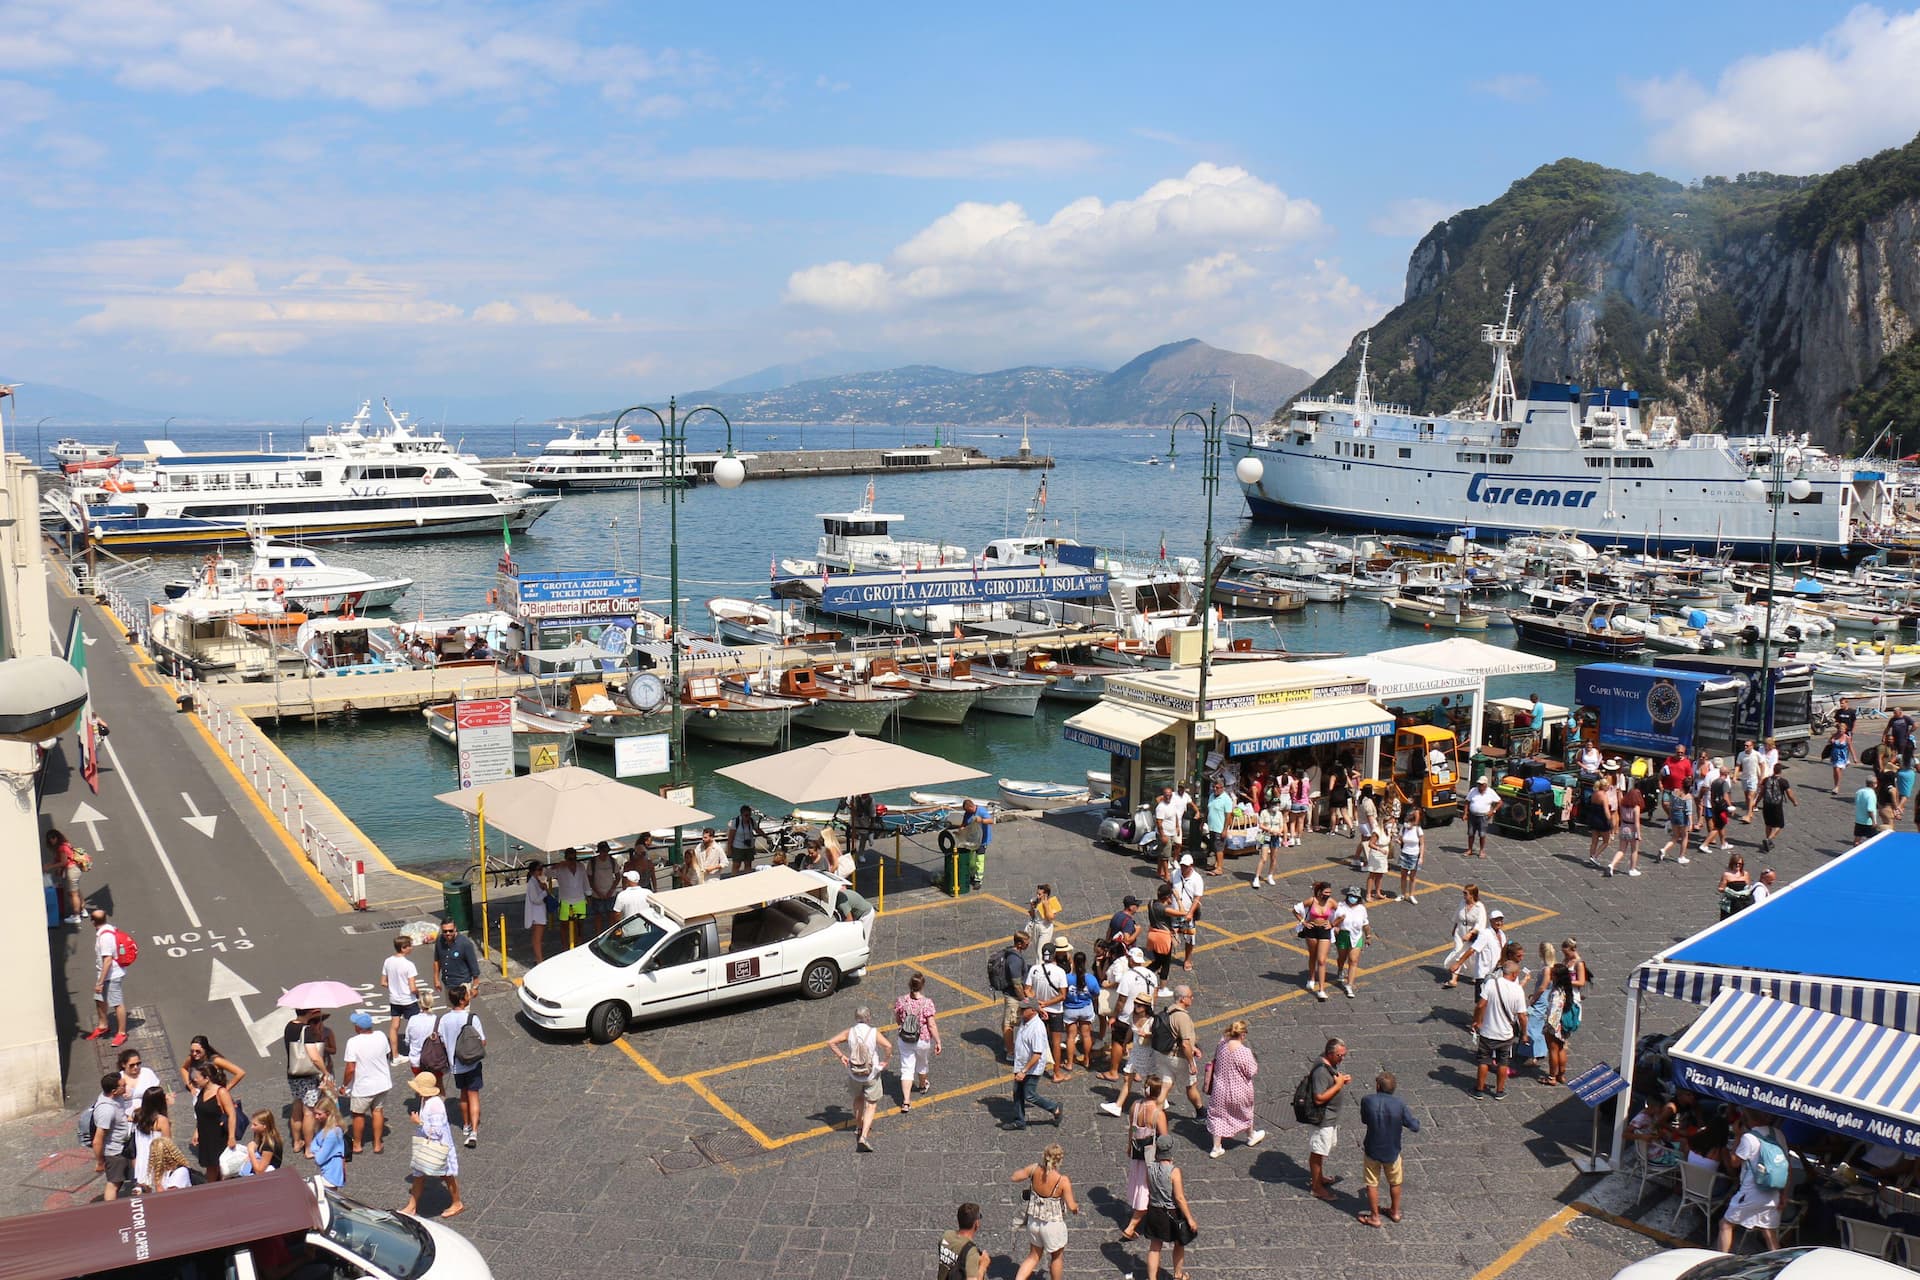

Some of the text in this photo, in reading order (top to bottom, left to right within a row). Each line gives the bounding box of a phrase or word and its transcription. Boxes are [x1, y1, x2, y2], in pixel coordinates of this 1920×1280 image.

[350, 486, 388, 497] NLG
[1467, 473, 1597, 508] Caremar
[542, 579, 621, 590] GROTTA AZZURRA
[863, 584, 916, 601] GROTTA
[919, 581, 974, 599] AZZURRA
[984, 580, 1015, 595] GIRO
[1017, 578, 1050, 594] DELL'
[1052, 577, 1085, 592] ISOLA
[550, 590, 582, 599] TICKET
[583, 588, 609, 597] POINT
[530, 602, 579, 615] Biglietteria
[581, 598, 639, 614] Ticket Office
[1314, 687, 1328, 695] BLUE
[1328, 685, 1353, 694] GROTTO
[1382, 680, 1442, 694] PORTABAGAGLI
[1446, 676, 1481, 688] STORAGE
[1589, 684, 1640, 700] CAPRI WATCH
[1228, 695, 1255, 704] GROTTO
[1256, 688, 1312, 700] TICKET POINT
[1258, 695, 1309, 705] boat tours
[1335, 690, 1353, 698] TOUR
[1235, 700, 1255, 708] TOUR
[1065, 728, 1078, 741] BLUE
[1078, 732, 1099, 748] GROTTO
[1102, 738, 1121, 754] ISLAND
[1232, 741, 1260, 755] TICKET
[1289, 734, 1308, 747] BLUE
[1310, 730, 1340, 745] GROTTO
[1344, 727, 1371, 740] ISLAND
[1371, 723, 1392, 736] TOUR
[152, 927, 247, 946] MOLI
[167, 939, 255, 958] 0-13
[1685, 1067, 1713, 1088] Pizza
[1714, 1076, 1751, 1098] Panini
[1752, 1086, 1789, 1110] Salad
[1789, 1097, 1864, 1130] Hamburgher
[1866, 1118, 1903, 1144] Milk
[134, 1230, 150, 1261] CAPRESI
